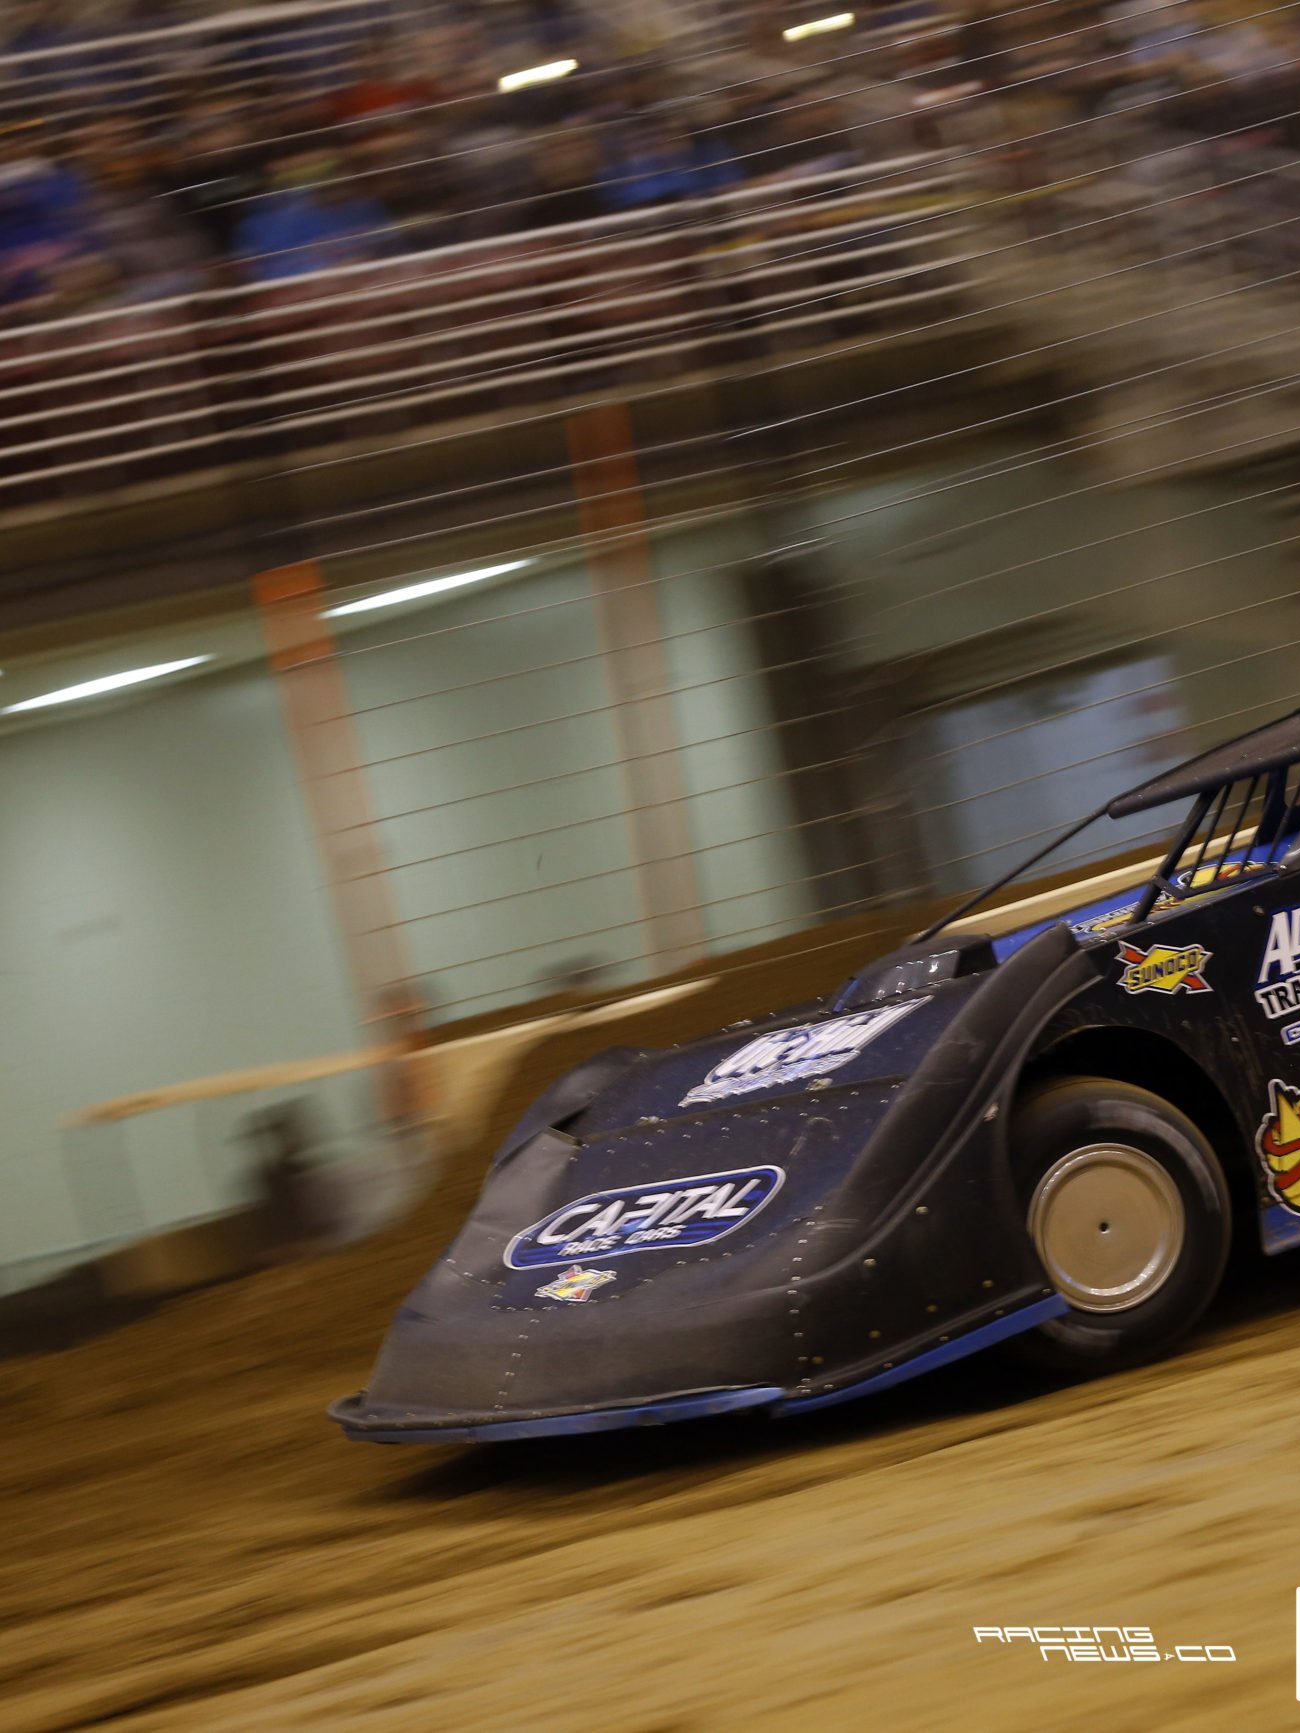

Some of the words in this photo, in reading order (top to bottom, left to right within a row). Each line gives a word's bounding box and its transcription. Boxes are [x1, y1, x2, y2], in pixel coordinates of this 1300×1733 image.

[1128, 950, 1200, 987] SUNOCO
[537, 1178, 761, 1245] CAPITAL
[558, 1235, 622, 1256] RACE
[624, 1224, 687, 1245] CARS
